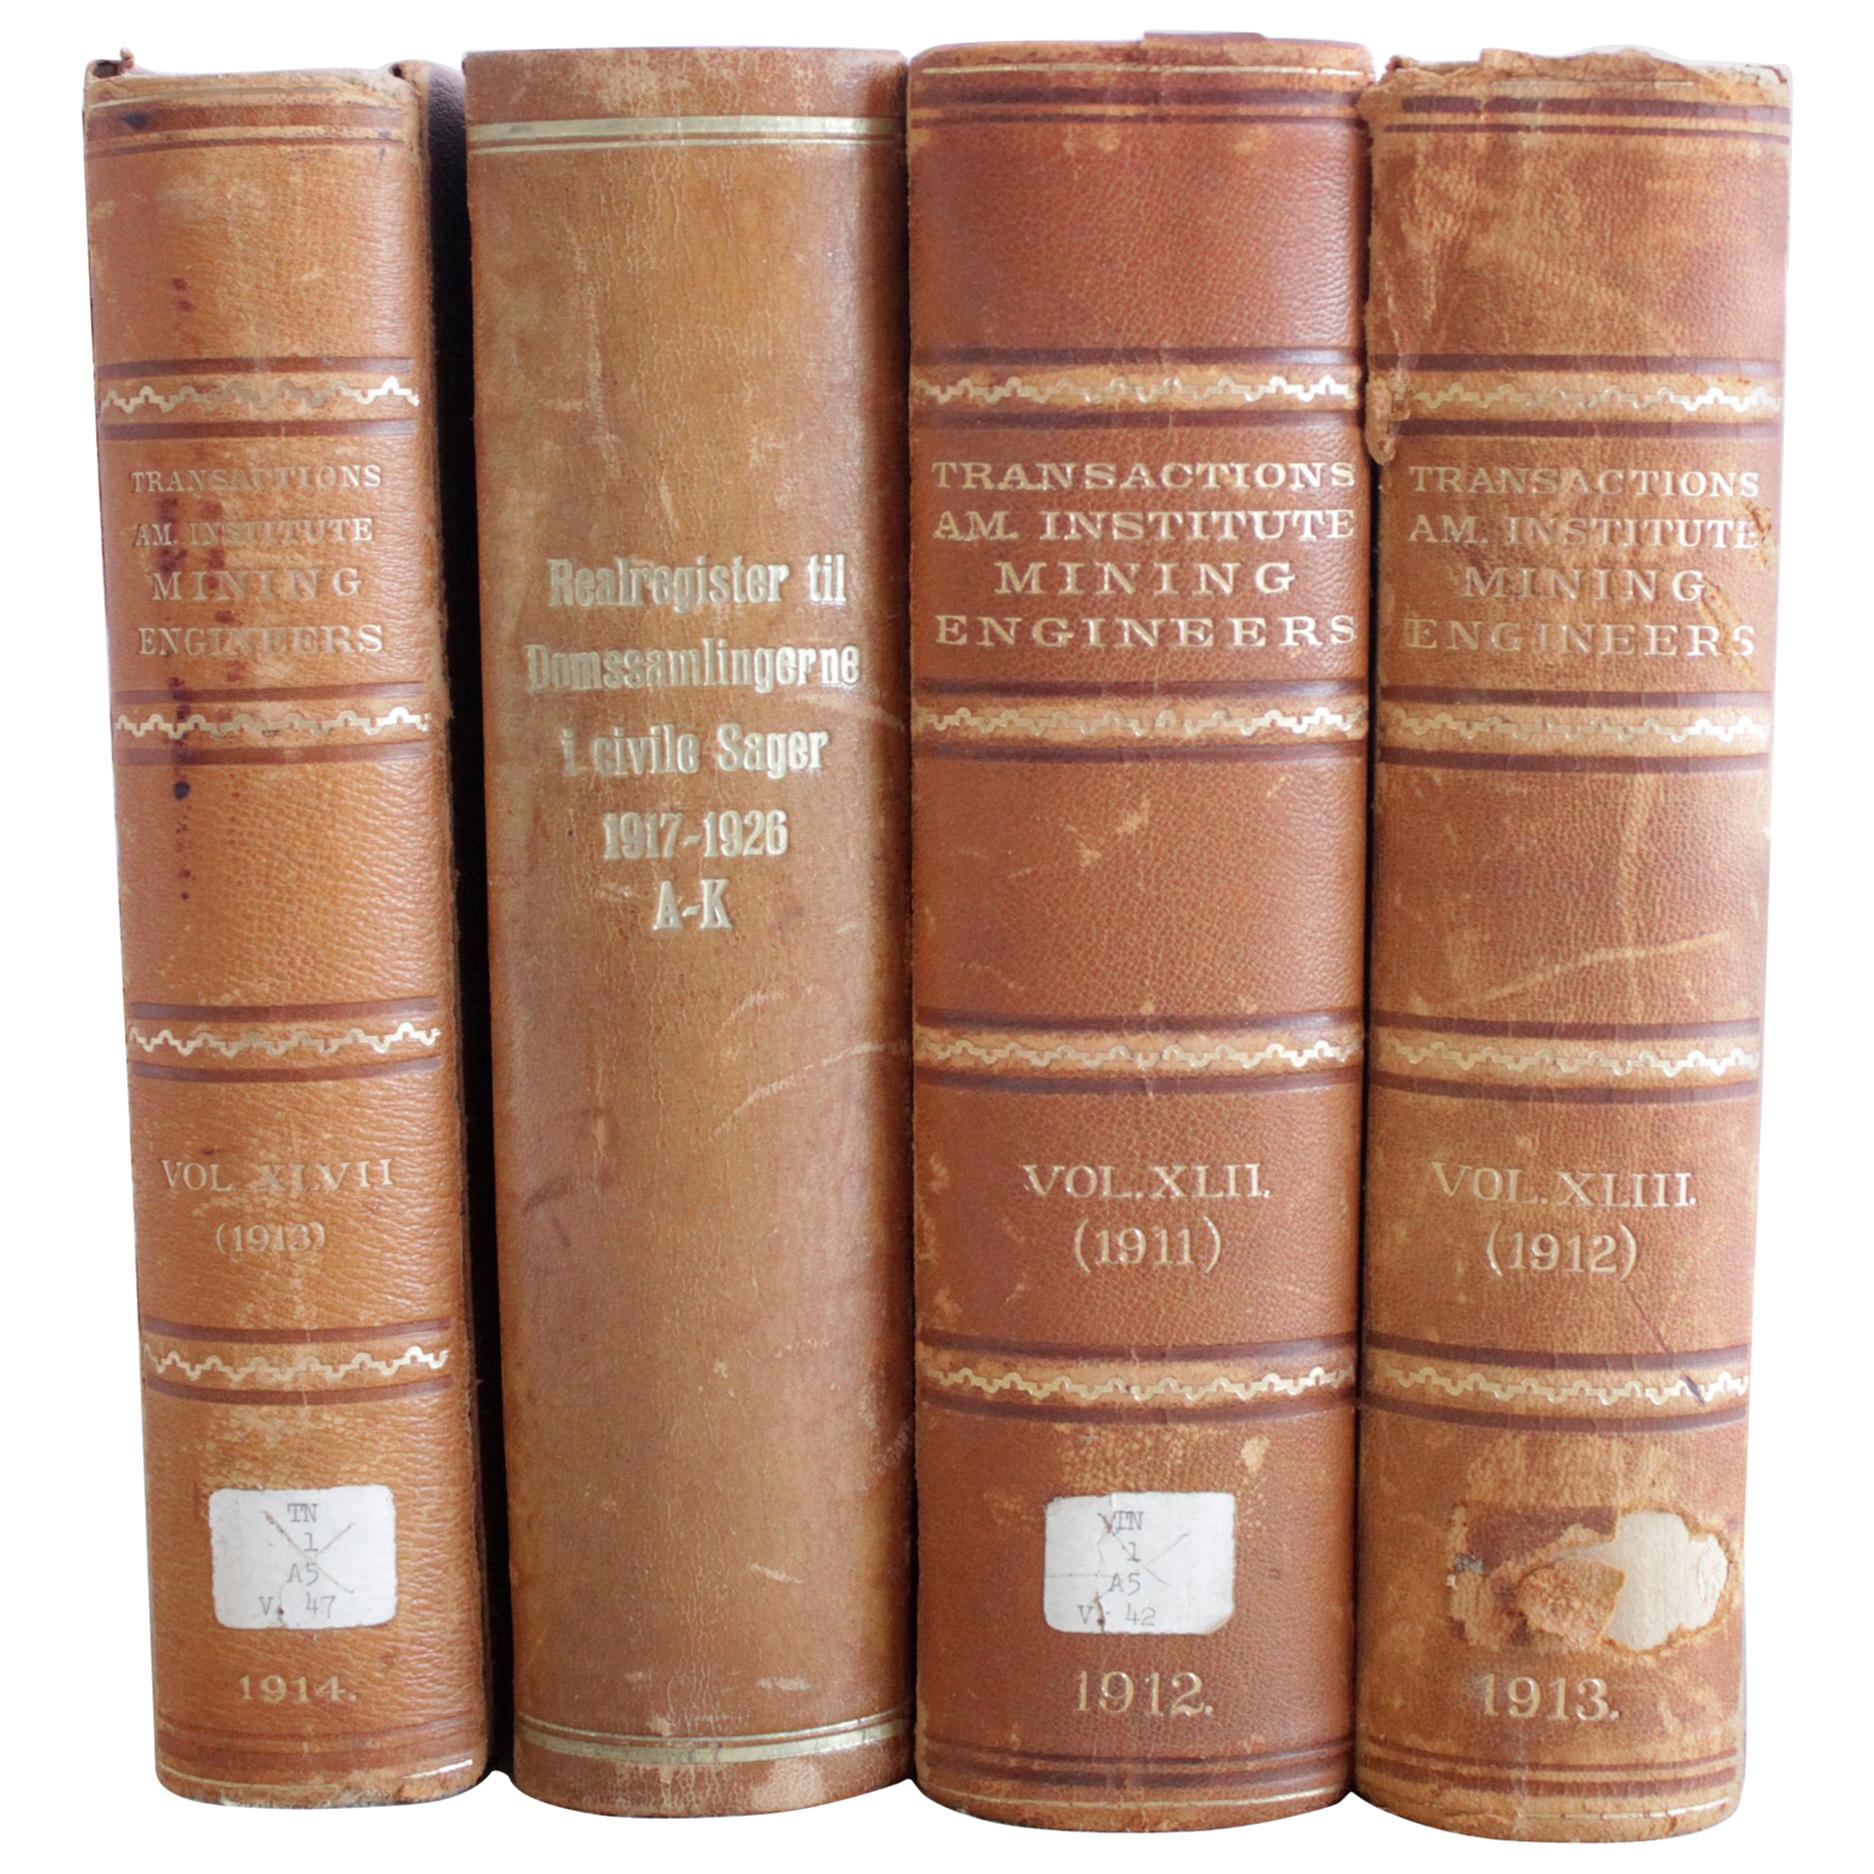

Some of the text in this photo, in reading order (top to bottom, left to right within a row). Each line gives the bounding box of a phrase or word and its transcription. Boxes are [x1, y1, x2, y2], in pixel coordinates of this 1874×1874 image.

[931, 462, 1355, 491] TRANSACTIONS
[1409, 466, 1760, 498] TRANSACTIONS
[1040, 509, 1355, 542] INSTITUTE
[1407, 514, 1759, 549] AM. INSTITUTE
[151, 567, 362, 602] MINING
[547, 553, 846, 612] Realregister til
[994, 561, 1296, 595] MINING
[1461, 566, 1705, 602] MINING
[138, 624, 384, 656] ENGINEERS
[935, 614, 1357, 648] ENGINEERS
[1405, 618, 1756, 657] ENGINEERS
[524, 637, 861, 694] Domssamlingerne
[592, 724, 699, 776] civile
[716, 723, 829, 779] Sager
[603, 809, 789, 861] 1917-1926
[652, 877, 733, 931] A-K
[215, 1221, 326, 1254] (1913)
[1074, 1215, 1222, 1274] (1911)
[1486, 1221, 1638, 1281] (1912)
[287, 1503, 319, 1523] TN
[1113, 1510, 1144, 1531] TN
[286, 1562, 319, 1586] A5
[1108, 1572, 1142, 1596] A5
[305, 1592, 337, 1618] 47
[1125, 1602, 1156, 1627] 42
[238, 1674, 359, 1704] 1914.
[1074, 1670, 1214, 1717] 1912.
[1476, 1673, 1620, 1722] 1913.
